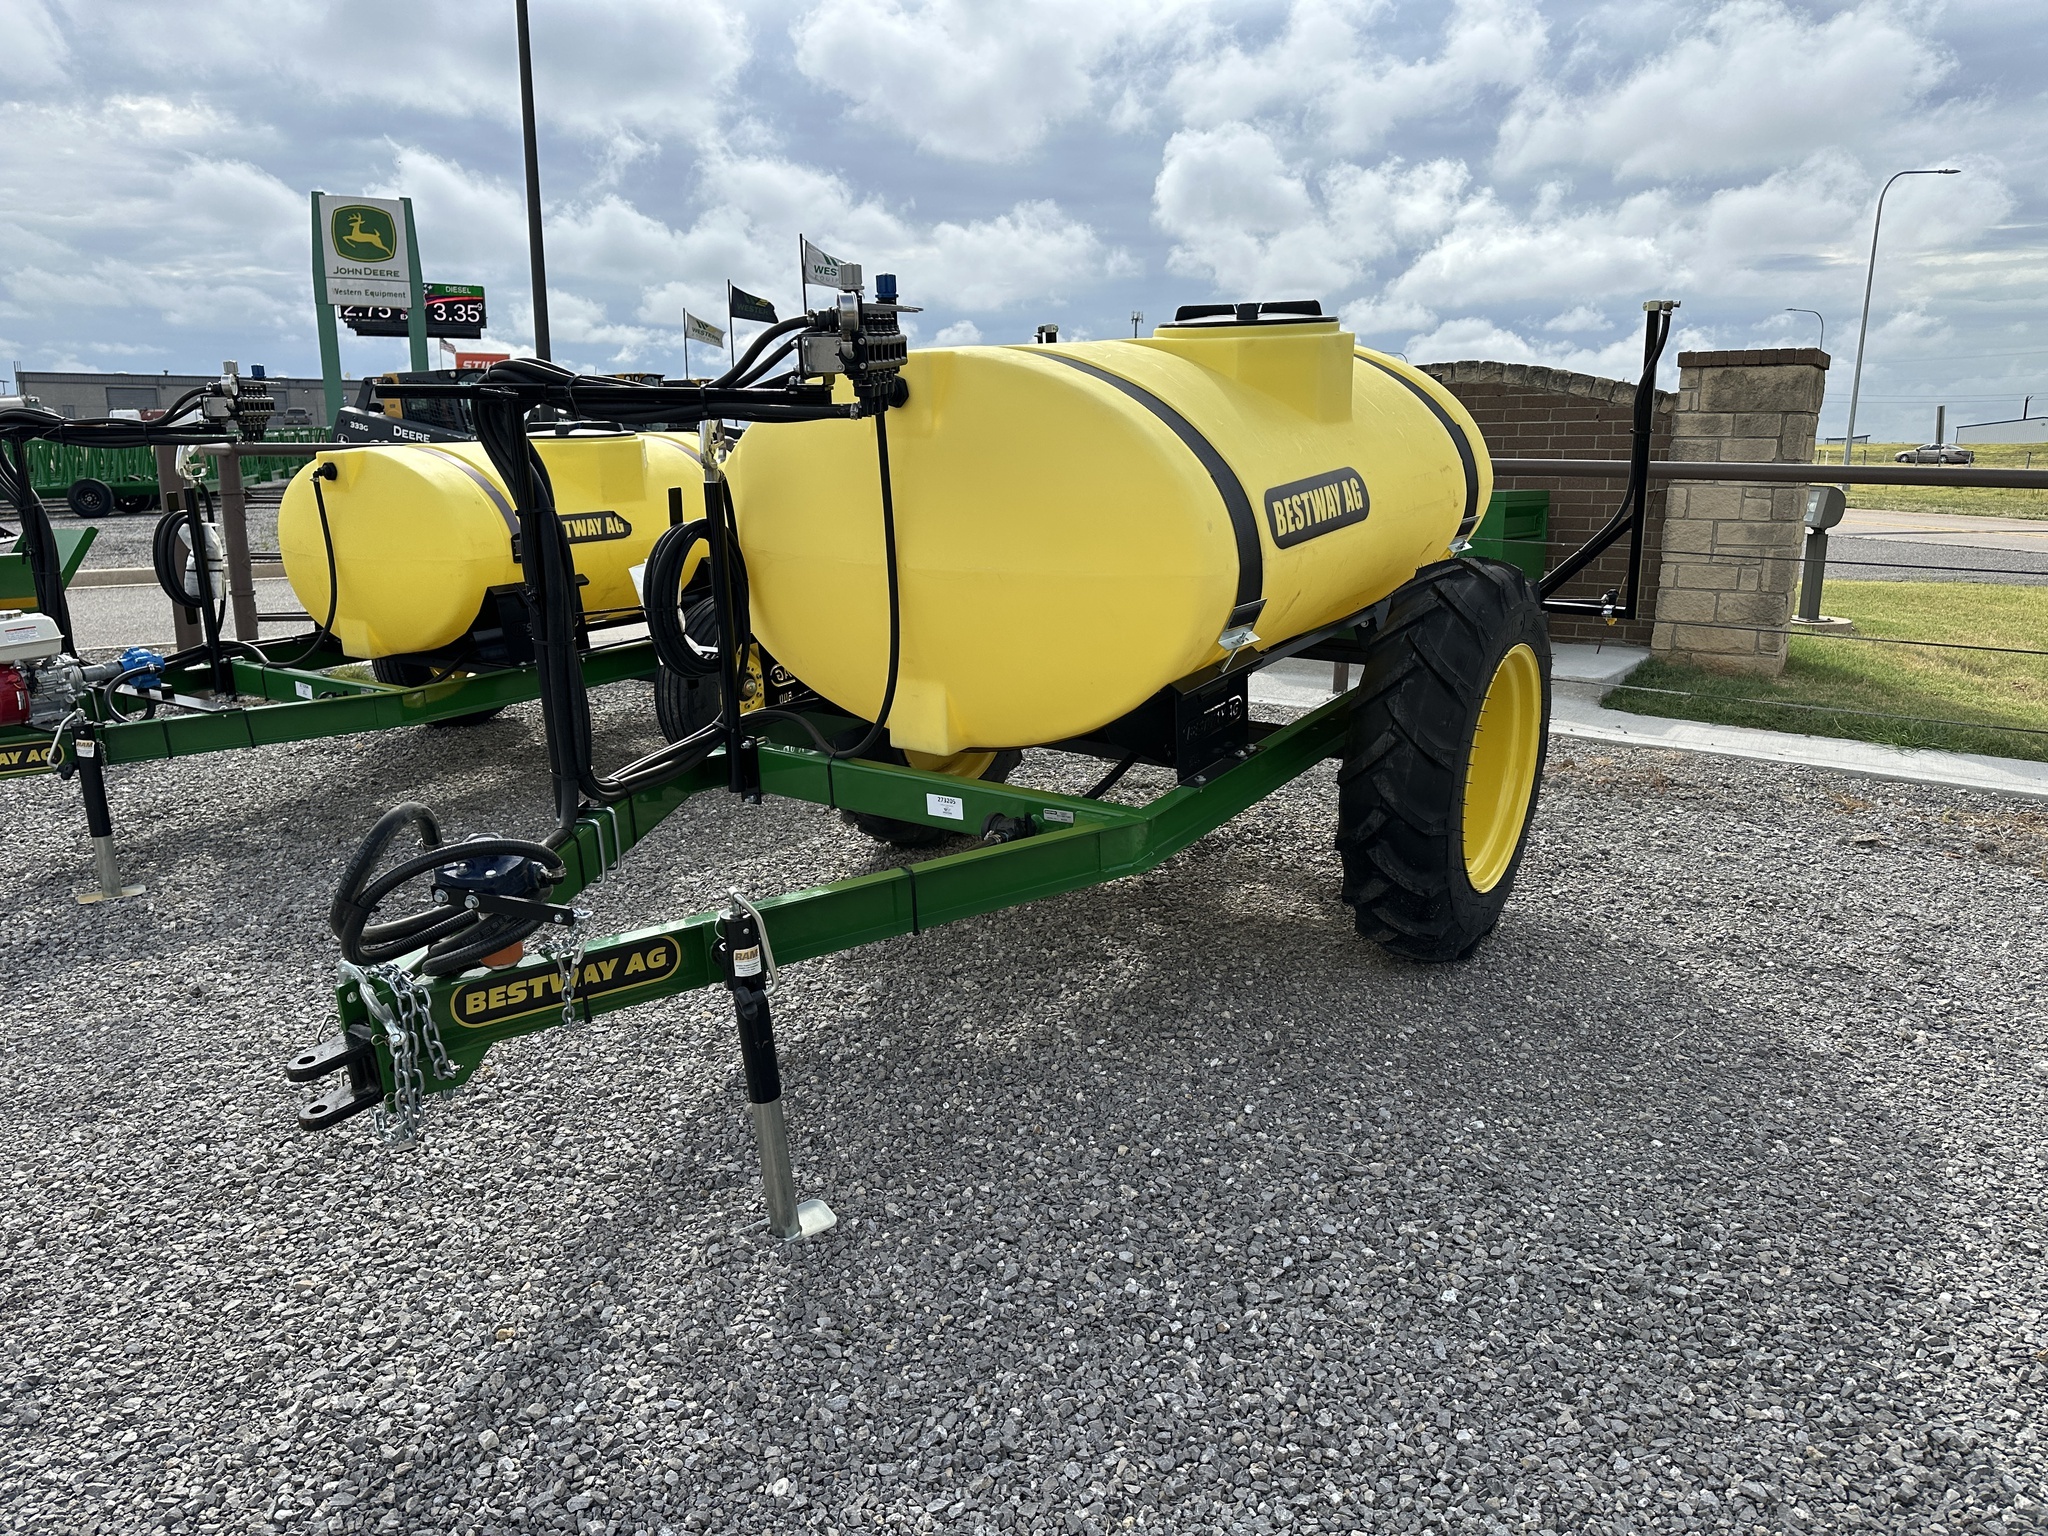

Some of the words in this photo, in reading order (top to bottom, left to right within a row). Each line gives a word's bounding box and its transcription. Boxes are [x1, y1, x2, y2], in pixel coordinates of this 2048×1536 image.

[333, 266, 363, 275] JOHN
[363, 267, 400, 277] DEERE
[814, 264, 840, 277] WES
[364, 289, 407, 299] Equipment
[445, 285, 471, 294] DIESEL
[350, 420, 369, 432] 333G
[393, 425, 430, 443] DEERE
[1272, 483, 1342, 537] BESTWAY
[1341, 477, 1364, 514] AG
[562, 518, 602, 538] TWAY
[606, 516, 625, 534] AG
[26, 747, 56, 763] AG
[735, 949, 759, 961] RAM
[465, 957, 619, 1016] BESTWAY
[625, 946, 668, 976] AG
